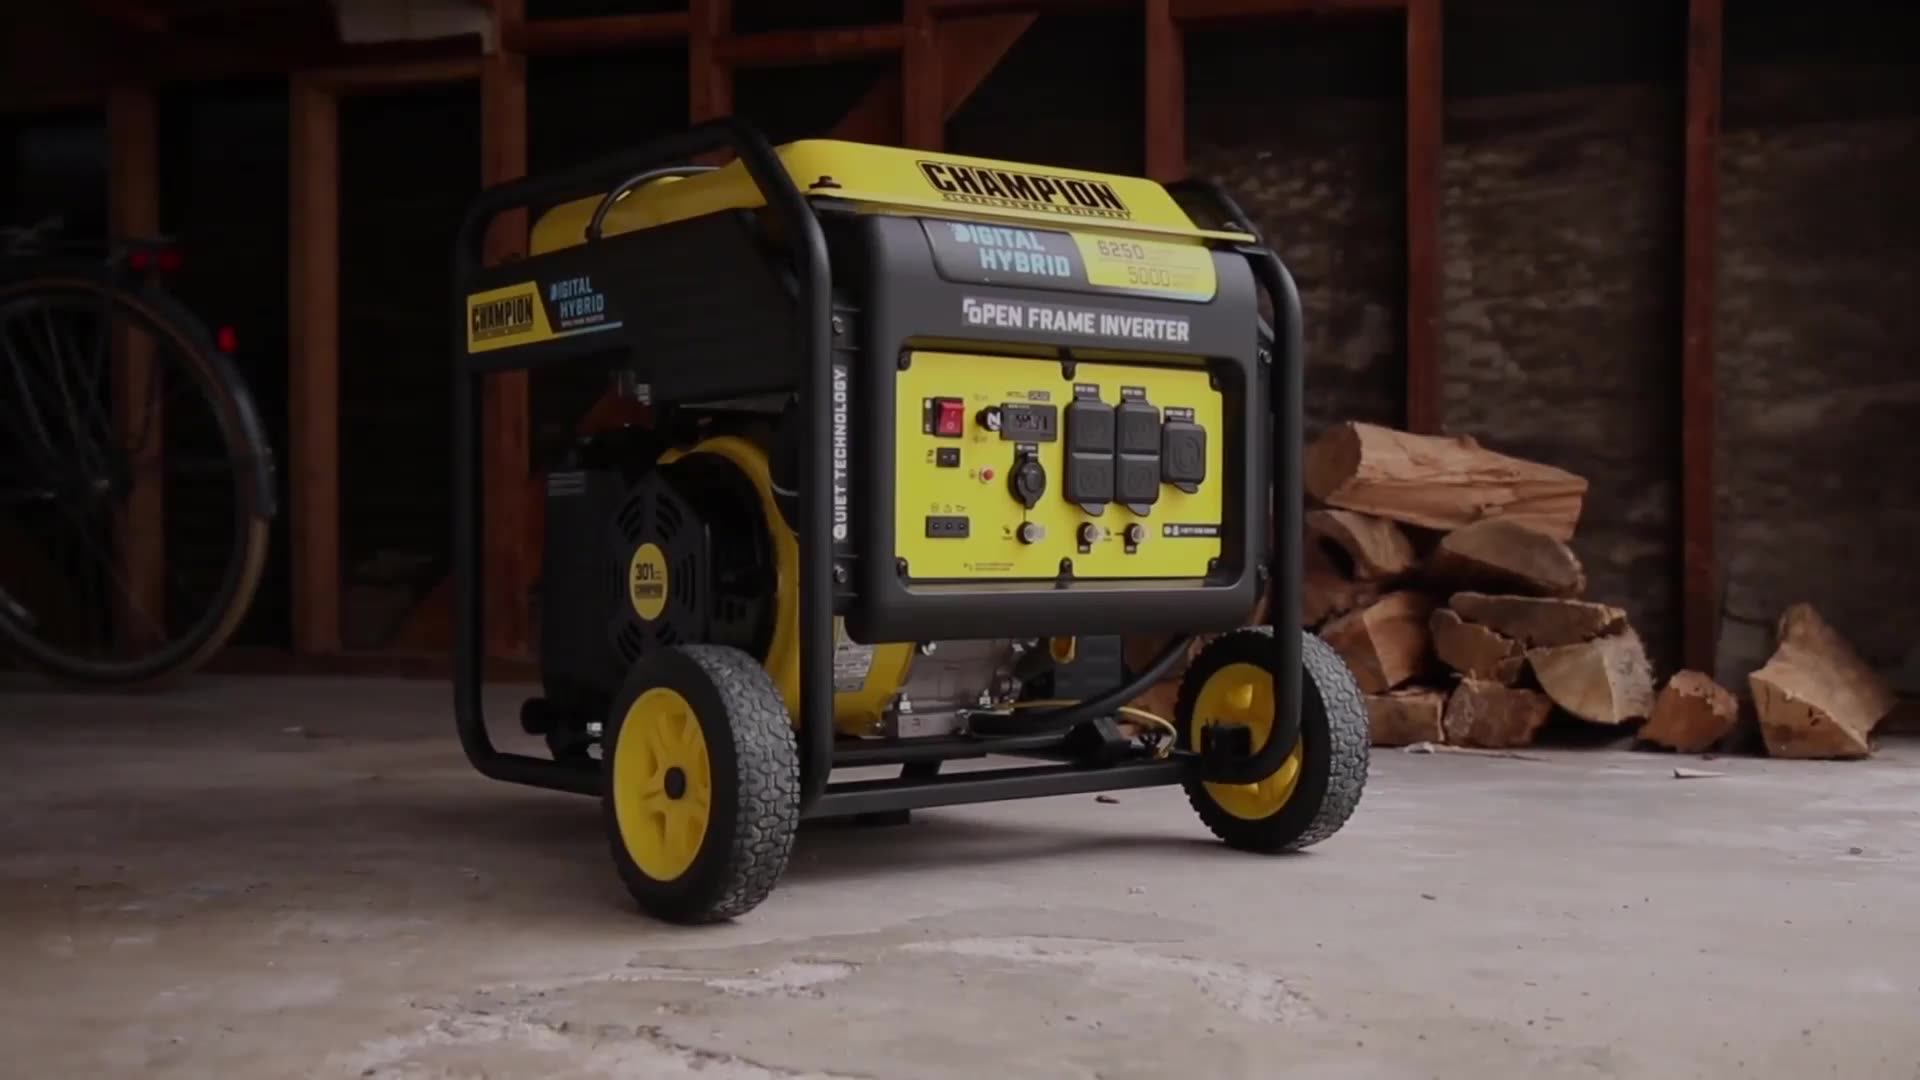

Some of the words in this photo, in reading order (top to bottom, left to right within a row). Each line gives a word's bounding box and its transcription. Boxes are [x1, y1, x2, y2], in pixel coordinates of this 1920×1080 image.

[922, 163, 1125, 210] CHAMPION
[949, 222, 1046, 252] DIGITAL
[1097, 239, 1145, 260] 6250
[979, 247, 1071, 277] HYBRID
[1128, 265, 1170, 287] 5000
[549, 276, 593, 302] DIGITAL
[473, 296, 533, 332] CHAMPION
[560, 293, 604, 319] HYBRID
[963, 298, 1023, 326] OPEN
[1027, 308, 1095, 333] FRAME
[1099, 315, 1190, 342] INVERTER
[832, 367, 848, 481] TECHNOLOGY
[832, 485, 848, 540] QUIET
[635, 562, 654, 581] 301
